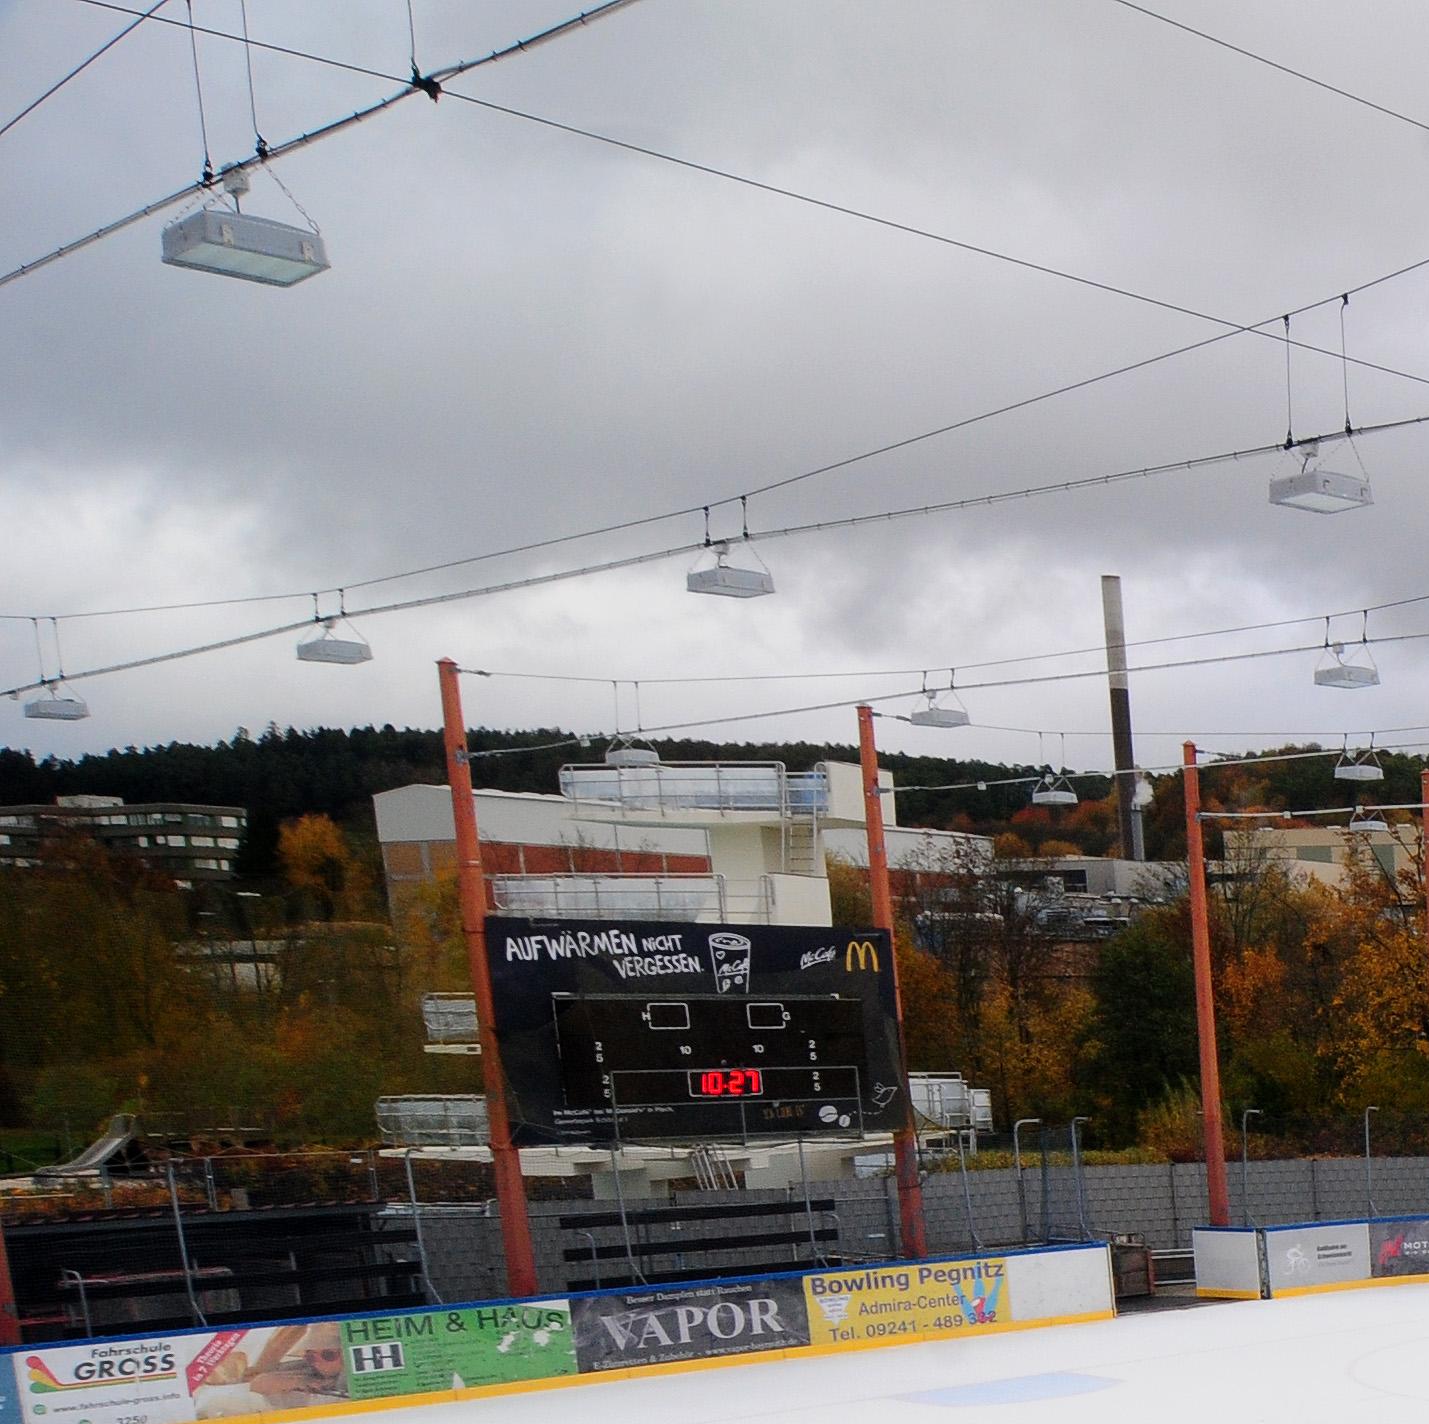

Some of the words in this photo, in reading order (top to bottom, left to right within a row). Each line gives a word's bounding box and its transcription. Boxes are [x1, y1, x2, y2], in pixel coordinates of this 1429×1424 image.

[506, 930, 638, 961] AUFWÄRMEN
[595, 1041, 602, 1051] 2
[680, 1045, 692, 1055] 10
[752, 1044, 764, 1054] 10
[808, 1039, 816, 1049] 2
[810, 1271, 910, 1296] Bowling
[919, 1261, 1004, 1287] Pegnitz
[859, 1293, 966, 1316] Admira-Center
[348, 1315, 434, 1343] HEIM
[447, 1312, 466, 1333] &
[476, 1307, 564, 1331] HAUS
[600, 1299, 785, 1351] VAPOR
[829, 1328, 861, 1342] Tel.
[866, 1319, 917, 1338] 09241
[933, 1314, 963, 1329] 489
[75, 1353, 175, 1380] GROSS
